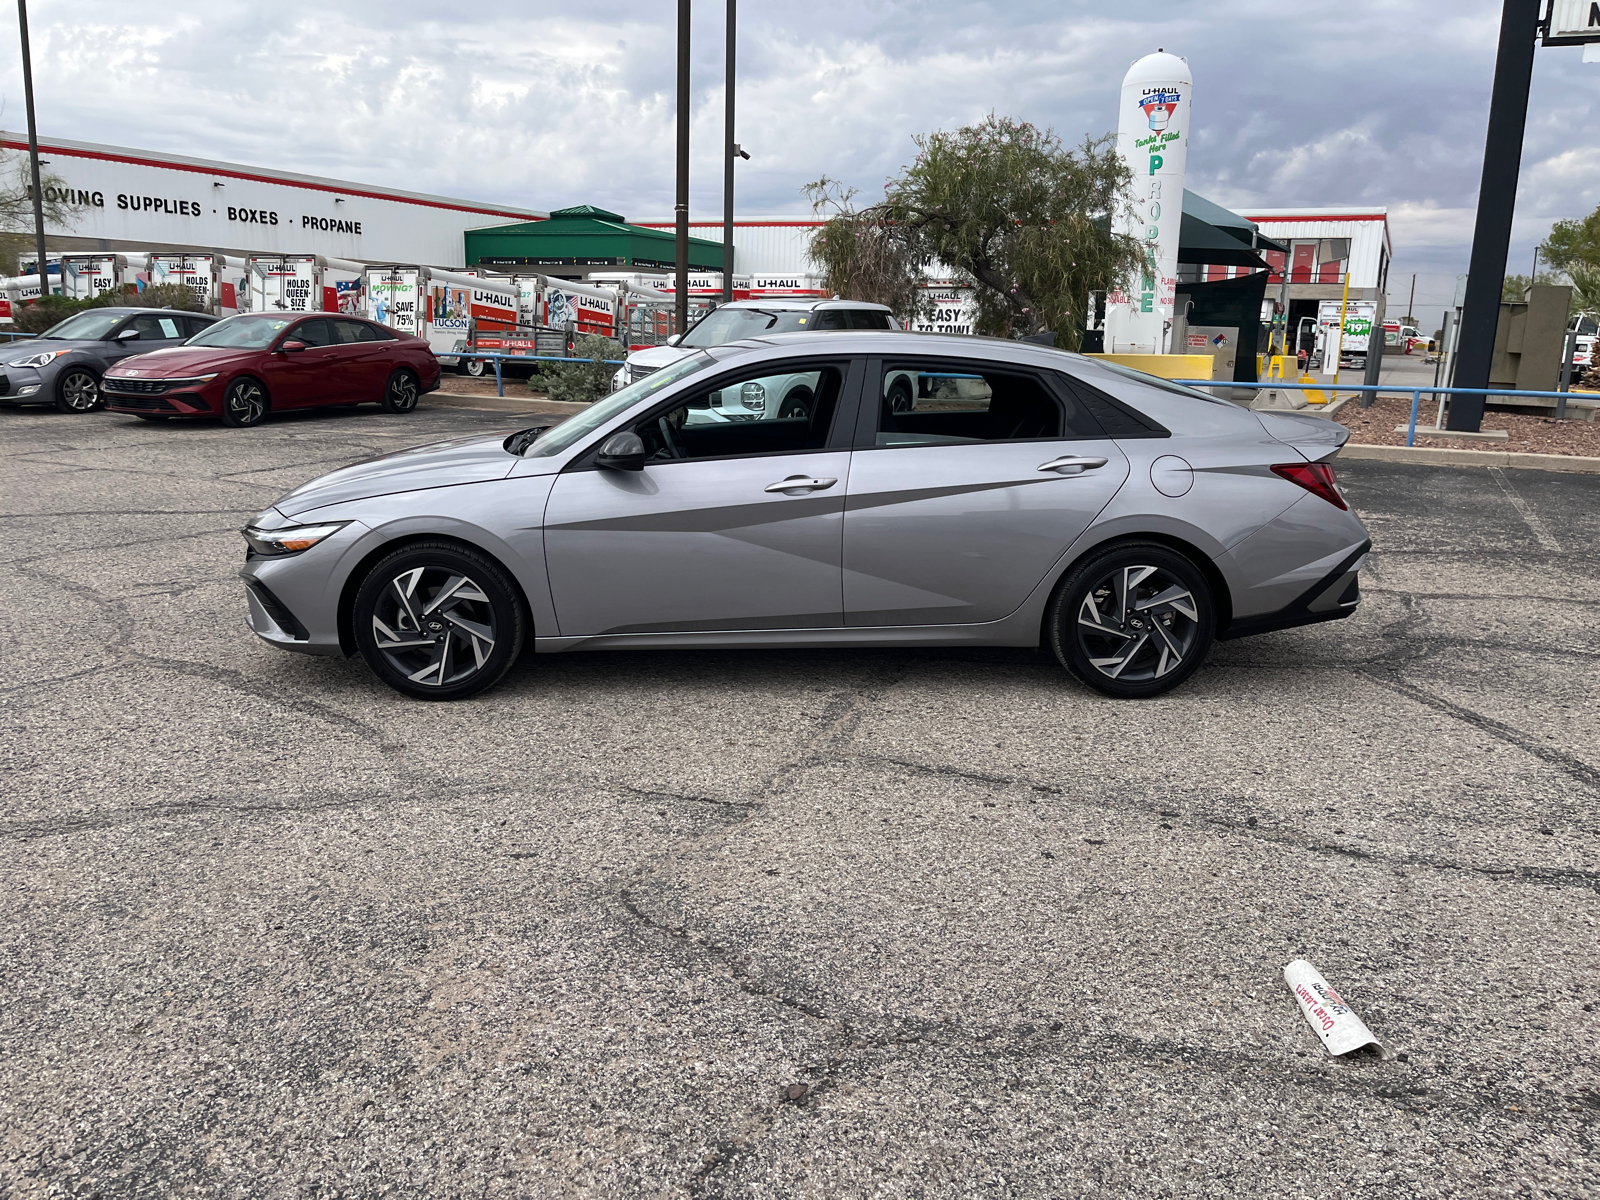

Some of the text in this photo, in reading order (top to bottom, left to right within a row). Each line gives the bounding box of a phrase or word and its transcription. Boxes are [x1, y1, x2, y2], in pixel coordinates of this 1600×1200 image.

[1142, 87, 1179, 95] U-HAUL
[1135, 130, 1180, 148] Tanks Filled
[1148, 143, 1166, 154] Here
[117, 193, 201, 217] SUPPLIES
[227, 206, 279, 225] BOXES
[302, 215, 362, 235] PROPANE
[1140, 154, 1163, 313] PROPANE
[78, 263, 101, 271] U-HAUL
[169, 262, 196, 270] U-HAUL
[267, 263, 296, 272] U-HAUL
[93, 278, 112, 289] EASY
[185, 276, 209, 285] HOLDS
[286, 279, 310, 289] HOLDS
[757, 279, 801, 288] U-HAUL
[21, 287, 43, 297] U-HA
[285, 288, 311, 298] QUEEN-
[371, 284, 413, 292] MOVING?
[290, 298, 306, 308] SIZE
[474, 290, 513, 308] U-HAUL
[580, 296, 611, 312] U-HAUL
[395, 301, 414, 313] SAVE
[396, 314, 414, 326] 75%
[930, 308, 962, 322] EASY
[433, 318, 467, 328] TUCSON
[502, 340, 533, 348] U-HAUL
[1313, 1006, 1335, 1031] Oscar
